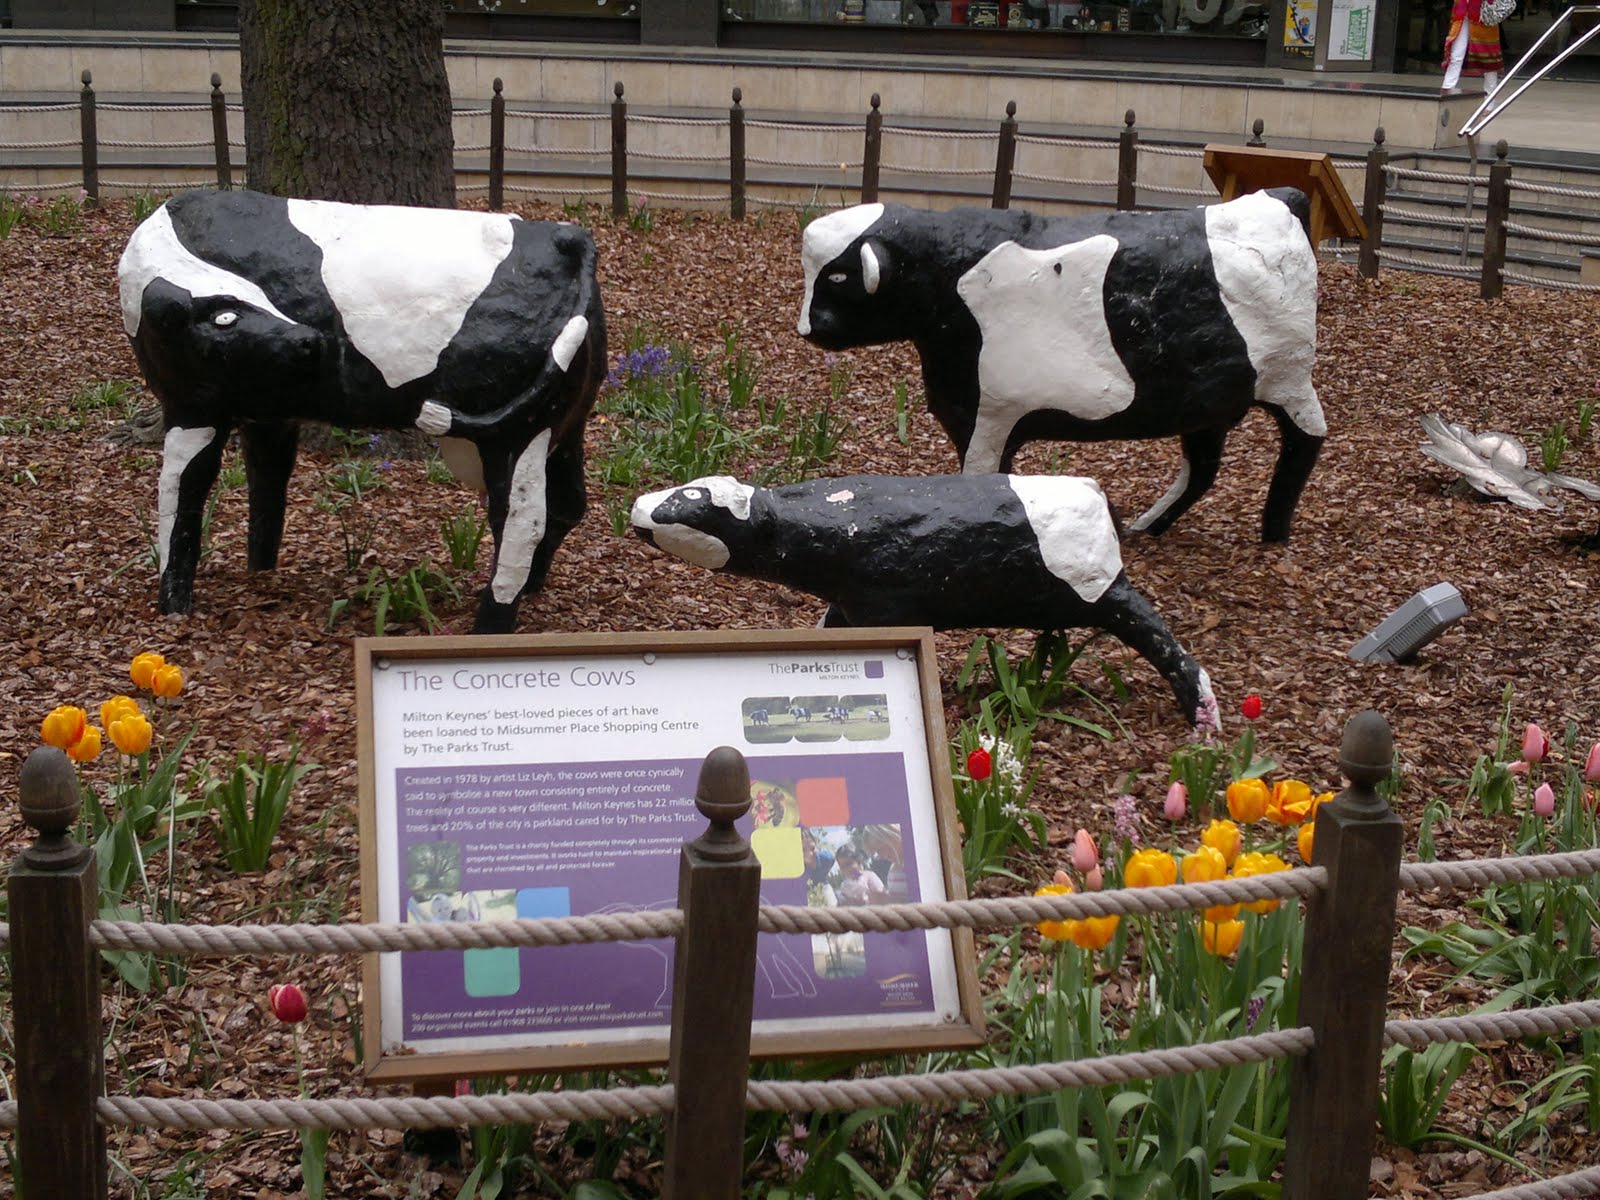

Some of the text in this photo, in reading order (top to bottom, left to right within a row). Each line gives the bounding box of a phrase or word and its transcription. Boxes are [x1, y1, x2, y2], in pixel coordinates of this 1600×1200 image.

[398, 667, 635, 690] The Concrete Cows
[403, 712, 442, 722] Milton
[494, 708, 554, 719] best-loved
[558, 707, 593, 719] pieces
[597, 706, 609, 716] of
[612, 706, 628, 716] art
[632, 705, 659, 715] have
[403, 720, 699, 738] been loaned to Midsummer Place Shopping Centre
[403, 741, 513, 755] by The Parks Trust.
[405, 775, 441, 785] Created
[443, 774, 452, 783] in
[455, 774, 478, 784] 1978
[480, 774, 491, 785] by
[493, 773, 515, 783] artist
[518, 772, 530, 782] Liz
[558, 770, 573, 780] the
[575, 771, 598, 779] cows
[601, 770, 622, 779] were
[625, 769, 646, 778] once
[648, 767, 684, 779] cynically
[405, 792, 423, 801] said
[425, 792, 435, 800] to
[493, 790, 512, 798] new
[515, 788, 538, 797] town
[540, 786, 584, 797] consisting
[587, 784, 619, 796] entirely
[621, 784, 631, 793] of
[406, 807, 422, 817] The
[425, 805, 453, 818] reality
[455, 805, 465, 815] of
[467, 805, 496, 814] course
[499, 804, 506, 813] is
[508, 804, 527, 814] very
[529, 801, 569, 812] different.
[573, 800, 601, 810] Milton
[604, 799, 635, 810] Keynes
[638, 798, 653, 807] has
[656, 798, 667, 807] 22
[406, 811, 698, 833] trees and 20% of the city is parkland cared for by The Parks Trust.
